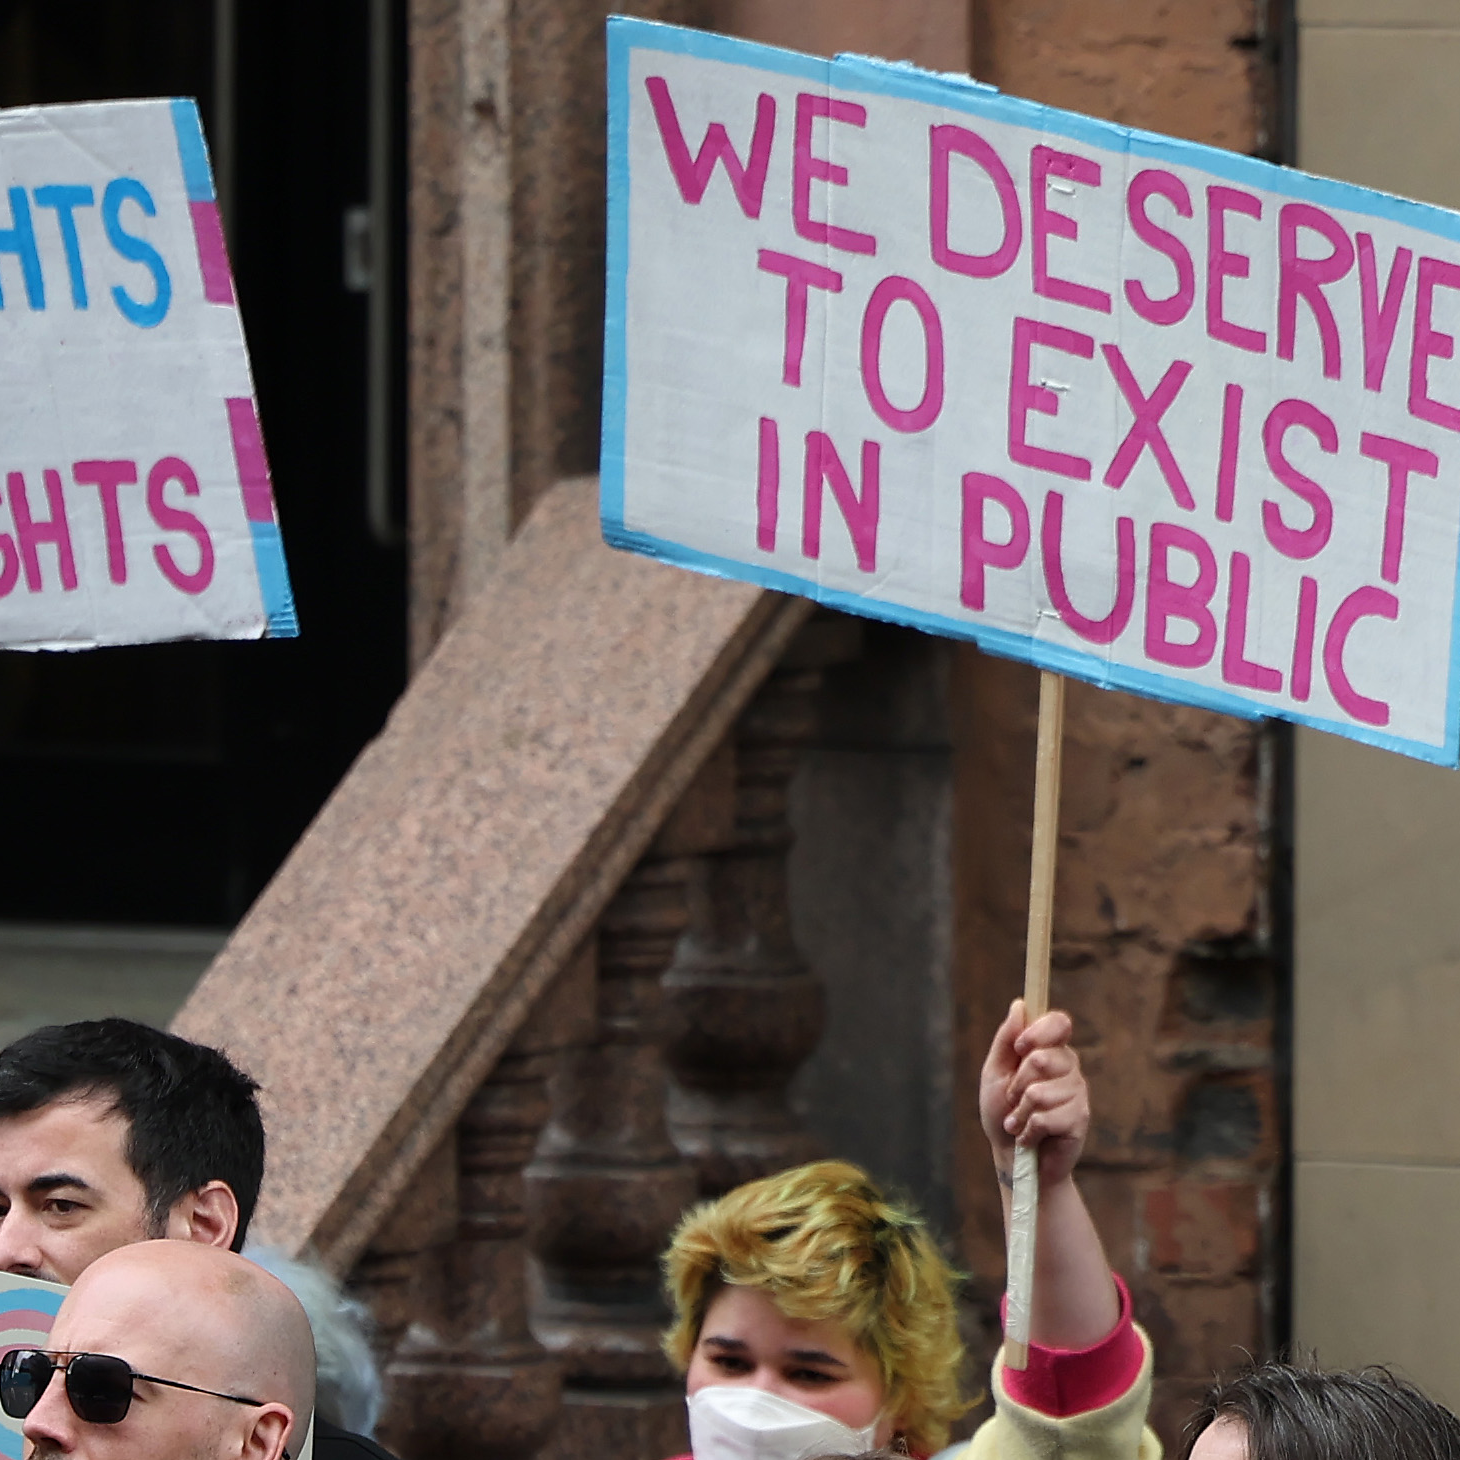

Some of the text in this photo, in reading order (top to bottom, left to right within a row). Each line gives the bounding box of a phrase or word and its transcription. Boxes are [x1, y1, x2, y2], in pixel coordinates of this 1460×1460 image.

[645, 76, 876, 257] WE
[758, 249, 1439, 584] TO EXIST
[757, 417, 1399, 728] IN PUBLIC
